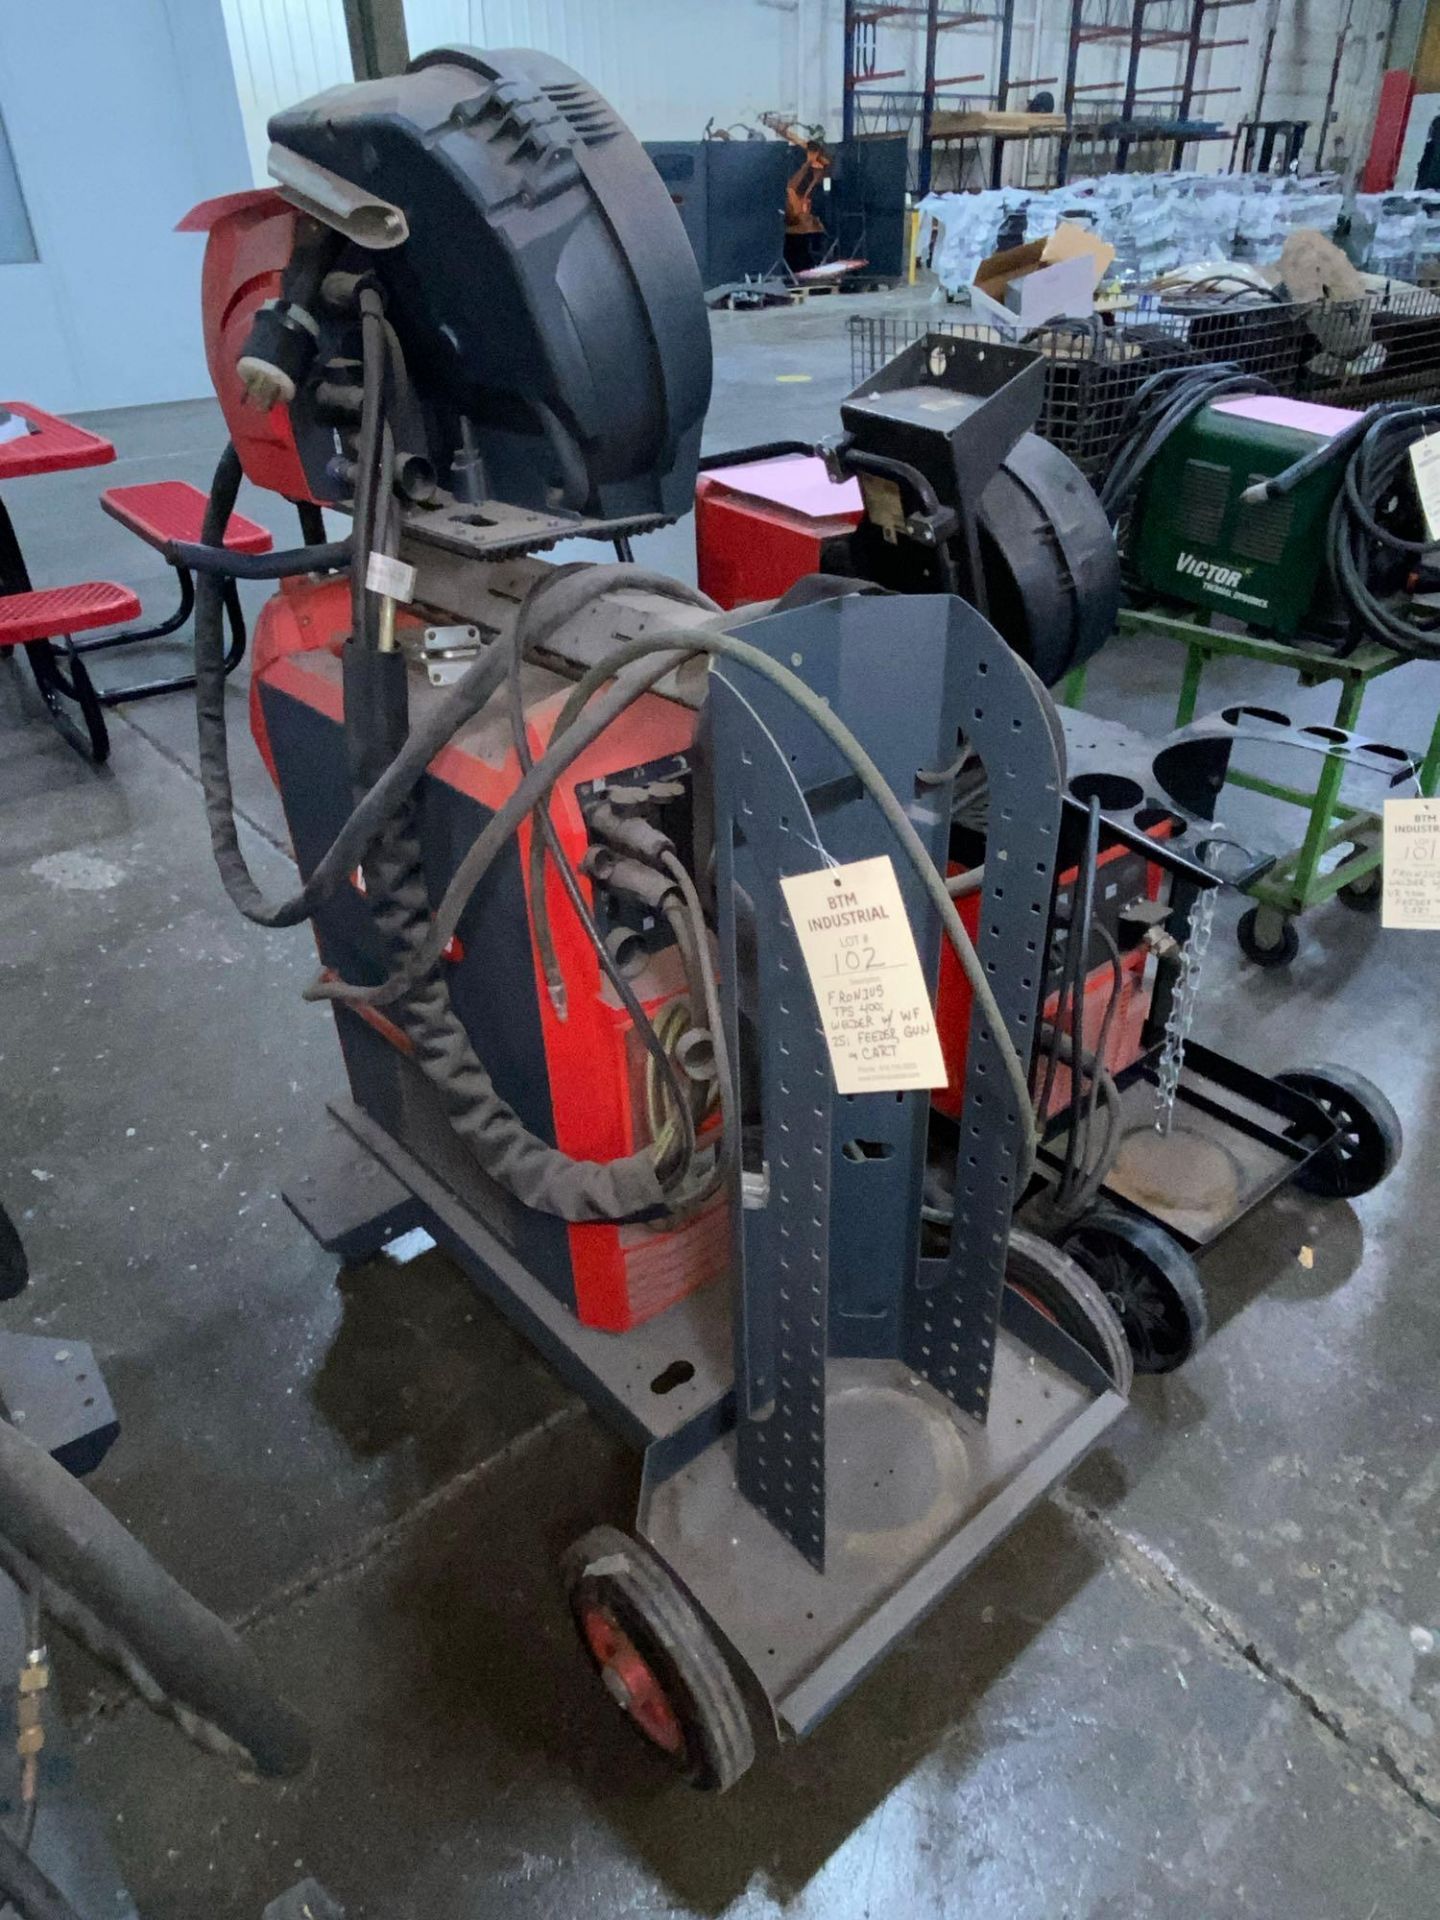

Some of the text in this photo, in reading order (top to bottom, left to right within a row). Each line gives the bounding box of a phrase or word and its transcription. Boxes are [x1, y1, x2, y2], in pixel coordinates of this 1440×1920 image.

[1176, 552, 1243, 588] VICTOR
[1414, 814, 1437, 823] BTM
[1404, 839, 1436, 861] 101
[827, 892, 858, 910] BTM
[808, 905, 890, 932] INDUSTRIAL
[840, 935, 859, 948] LOT
[834, 947, 886, 974] 102
[832, 1006, 854, 1018] TPS
[900, 1007, 920, 1021] WF
[903, 1023, 930, 1038] GUN
[861, 1045, 897, 1060] CART
